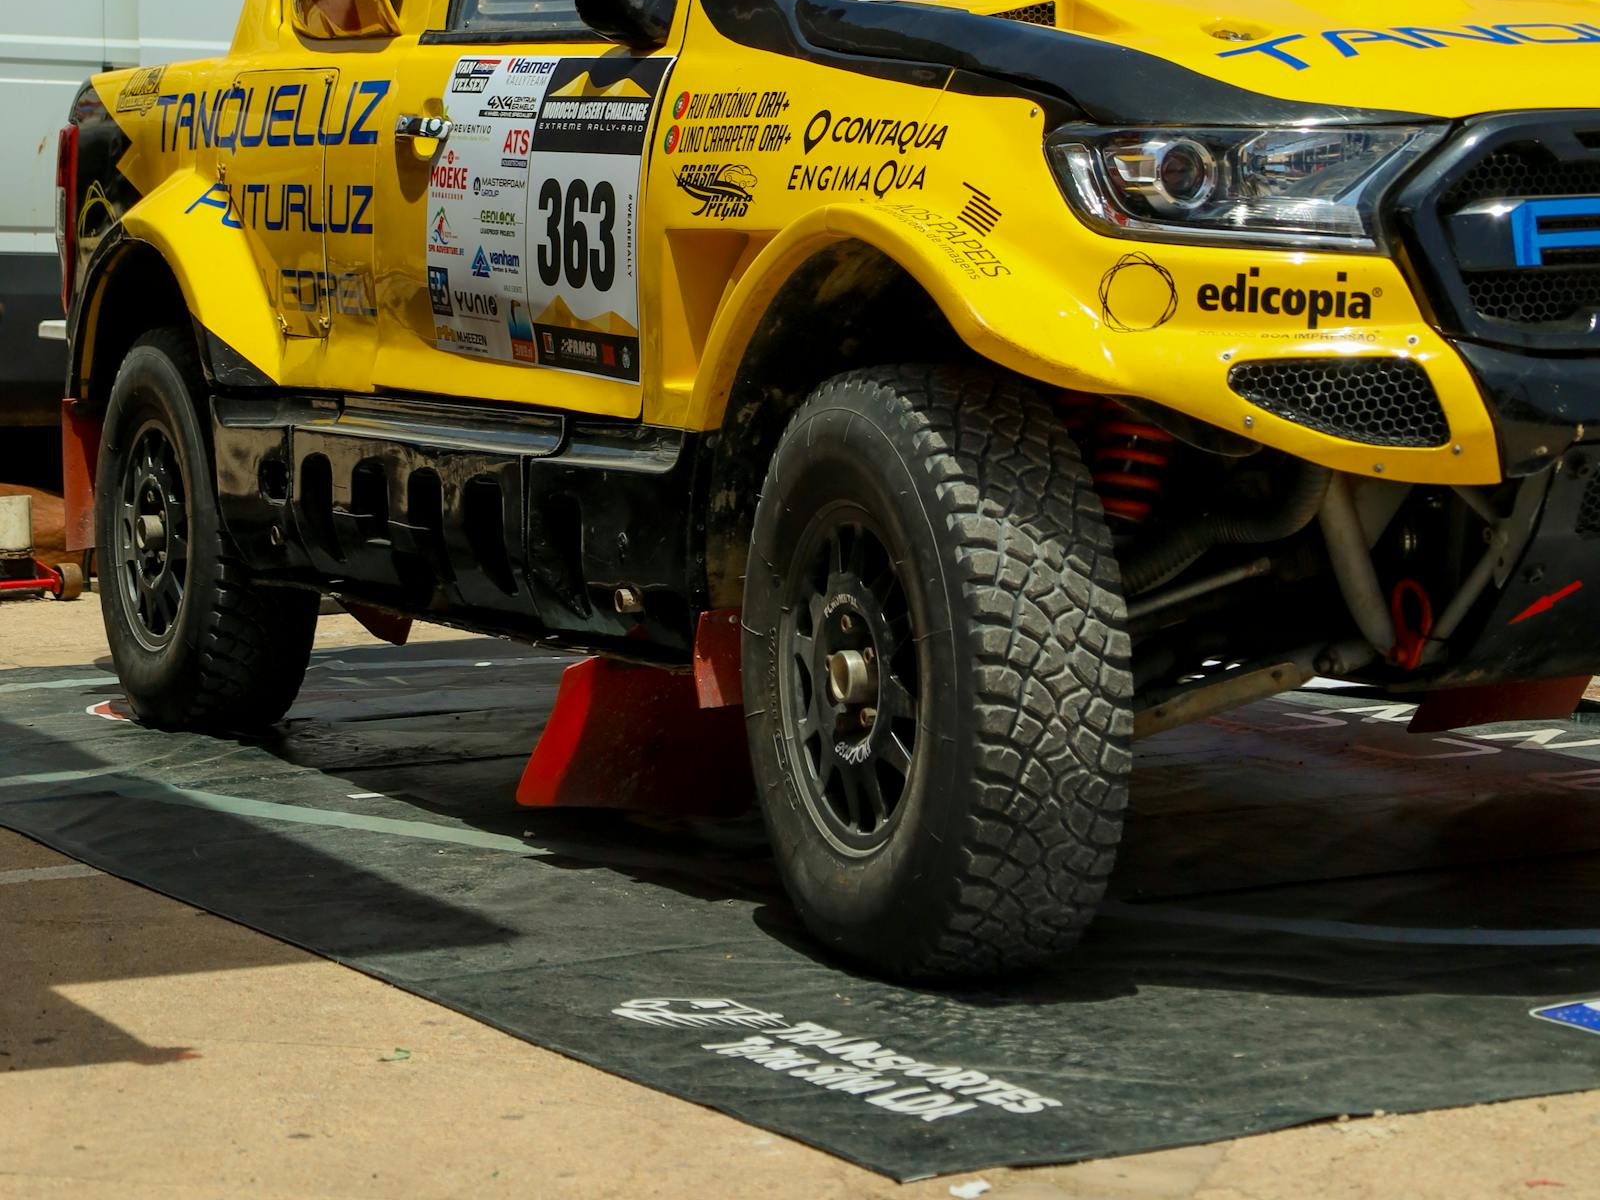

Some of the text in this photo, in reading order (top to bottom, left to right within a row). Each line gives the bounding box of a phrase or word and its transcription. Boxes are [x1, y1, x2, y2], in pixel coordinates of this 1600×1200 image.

[456, 60, 474, 75] VAN
[511, 58, 556, 74] Hamer
[452, 77, 488, 92] VELSEN
[541, 101, 650, 121] MOROCCO DESERT CHALLENGE
[686, 93, 710, 119] RUI
[708, 87, 757, 119] ANTÓNIO
[157, 79, 391, 156] TANQUELUZ
[538, 122, 644, 133] EXTREME RALLY-RAID
[503, 129, 530, 155] ATS
[678, 126, 704, 153] LINO
[703, 125, 759, 152] CARAPETA
[831, 116, 949, 154] CONTAQUA
[430, 166, 468, 190] MOEKE
[481, 177, 526, 189] MASTERFOAM
[787, 159, 927, 199] ENGIMAQUA
[185, 183, 373, 234] FUTURLUZ
[537, 178, 616, 292] 363
[489, 250, 520, 267] vanham
[761, 1021, 1064, 1114] TRANSPORTES
